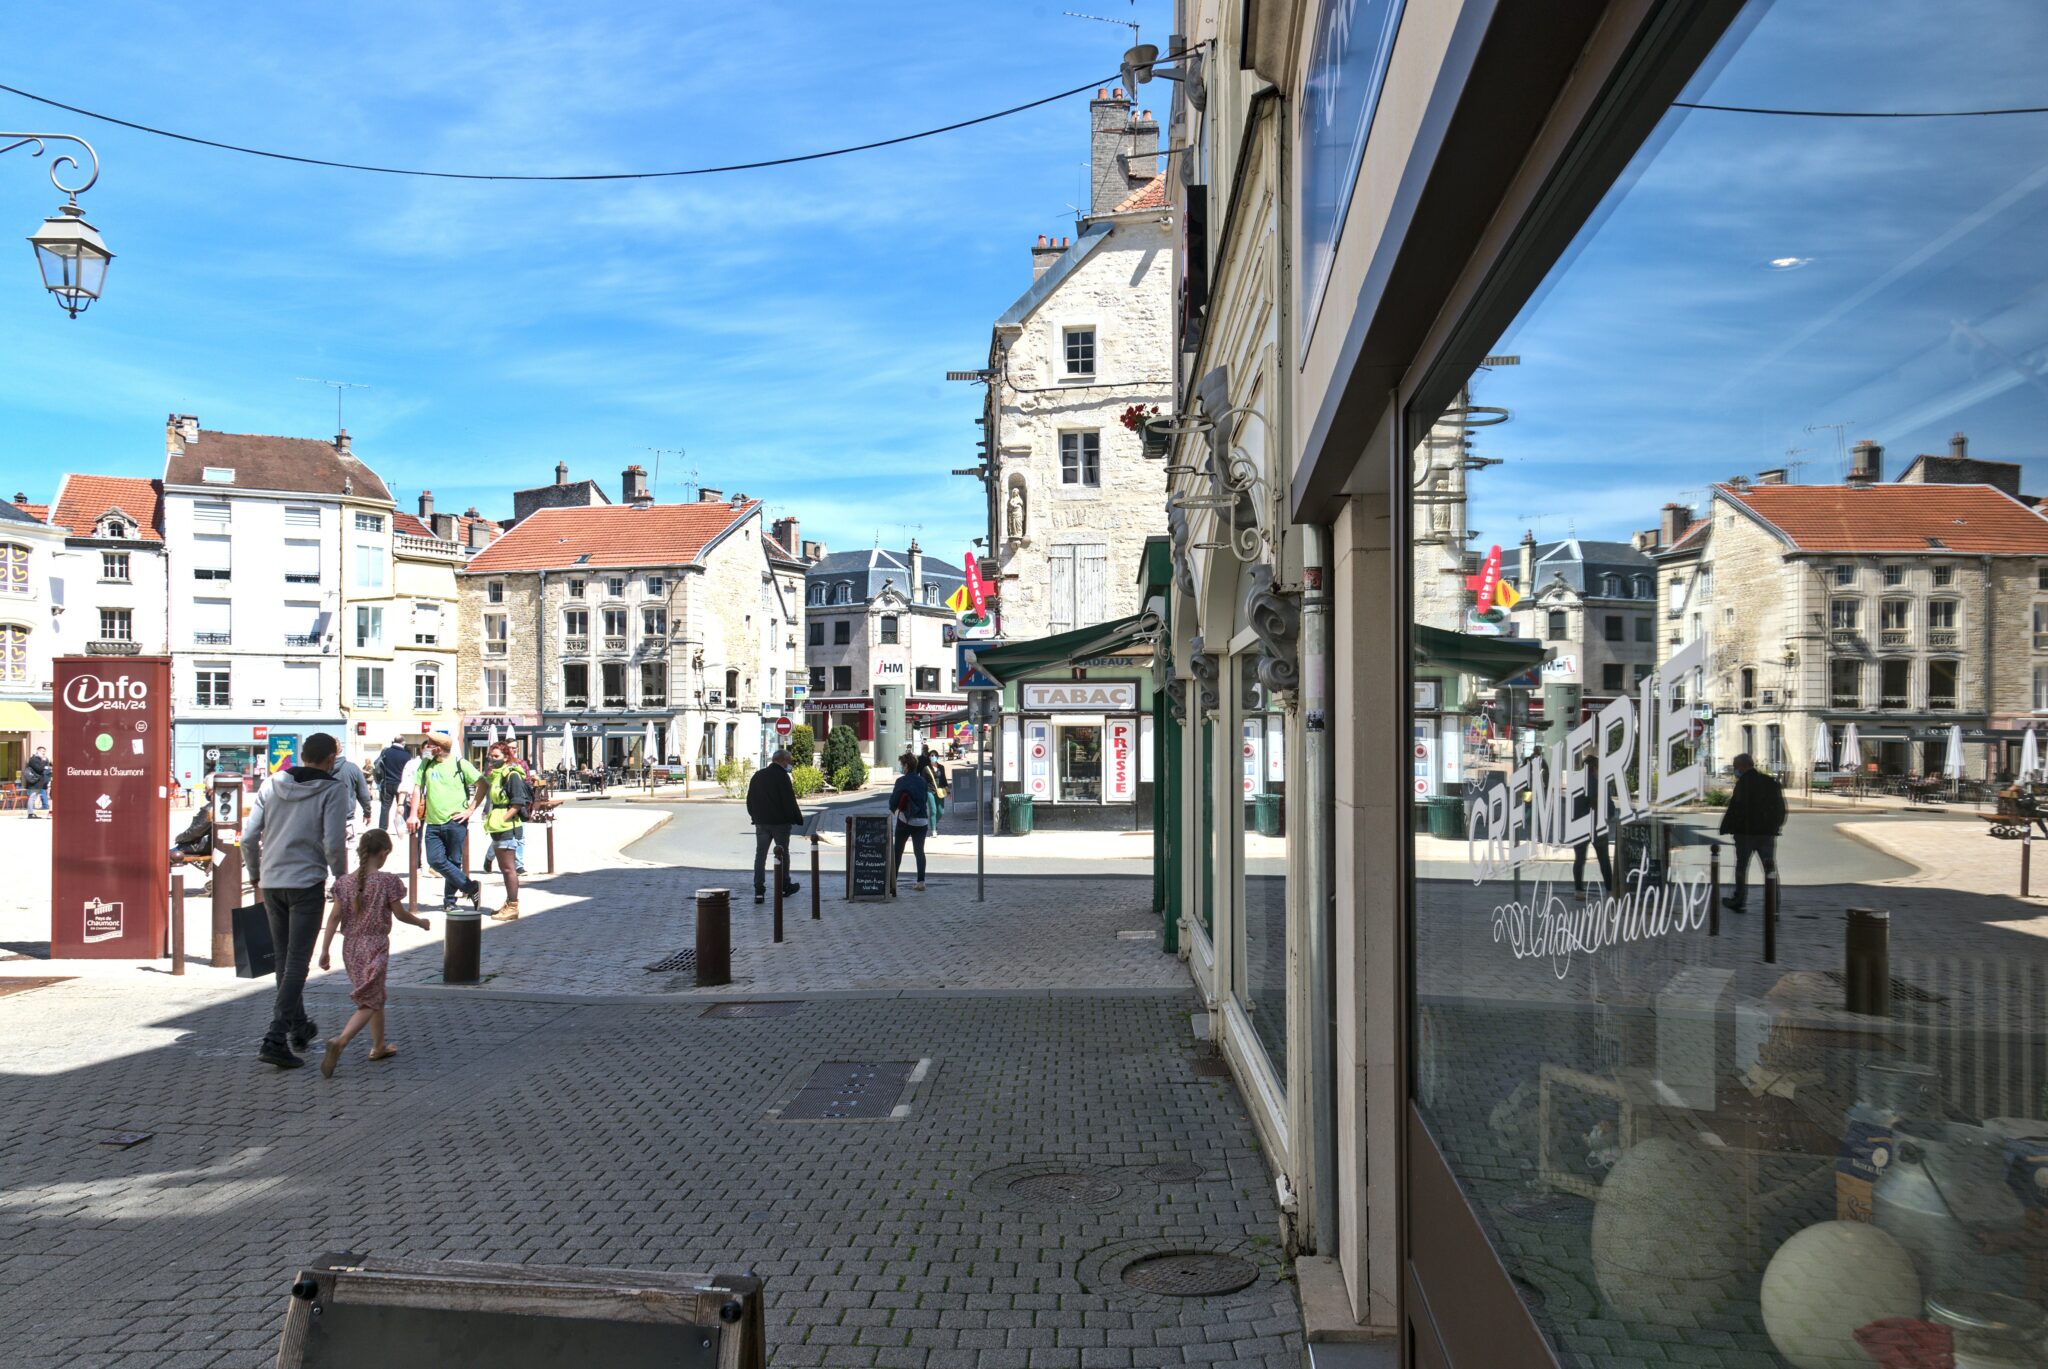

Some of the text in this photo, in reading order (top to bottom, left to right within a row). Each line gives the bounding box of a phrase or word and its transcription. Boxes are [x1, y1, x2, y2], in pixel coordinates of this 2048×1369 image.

[967, 564, 983, 605] TABAC
[63, 674, 148, 713] info
[103, 700, 147, 710] 24h/24
[1032, 689, 1128, 704] TABAC
[67, 767, 101, 776] Bienvenue
[109, 767, 144, 776] Chaumont
[1113, 726, 1128, 793] PRESSE
[1491, 846, 1712, 979] Chaumontaise
